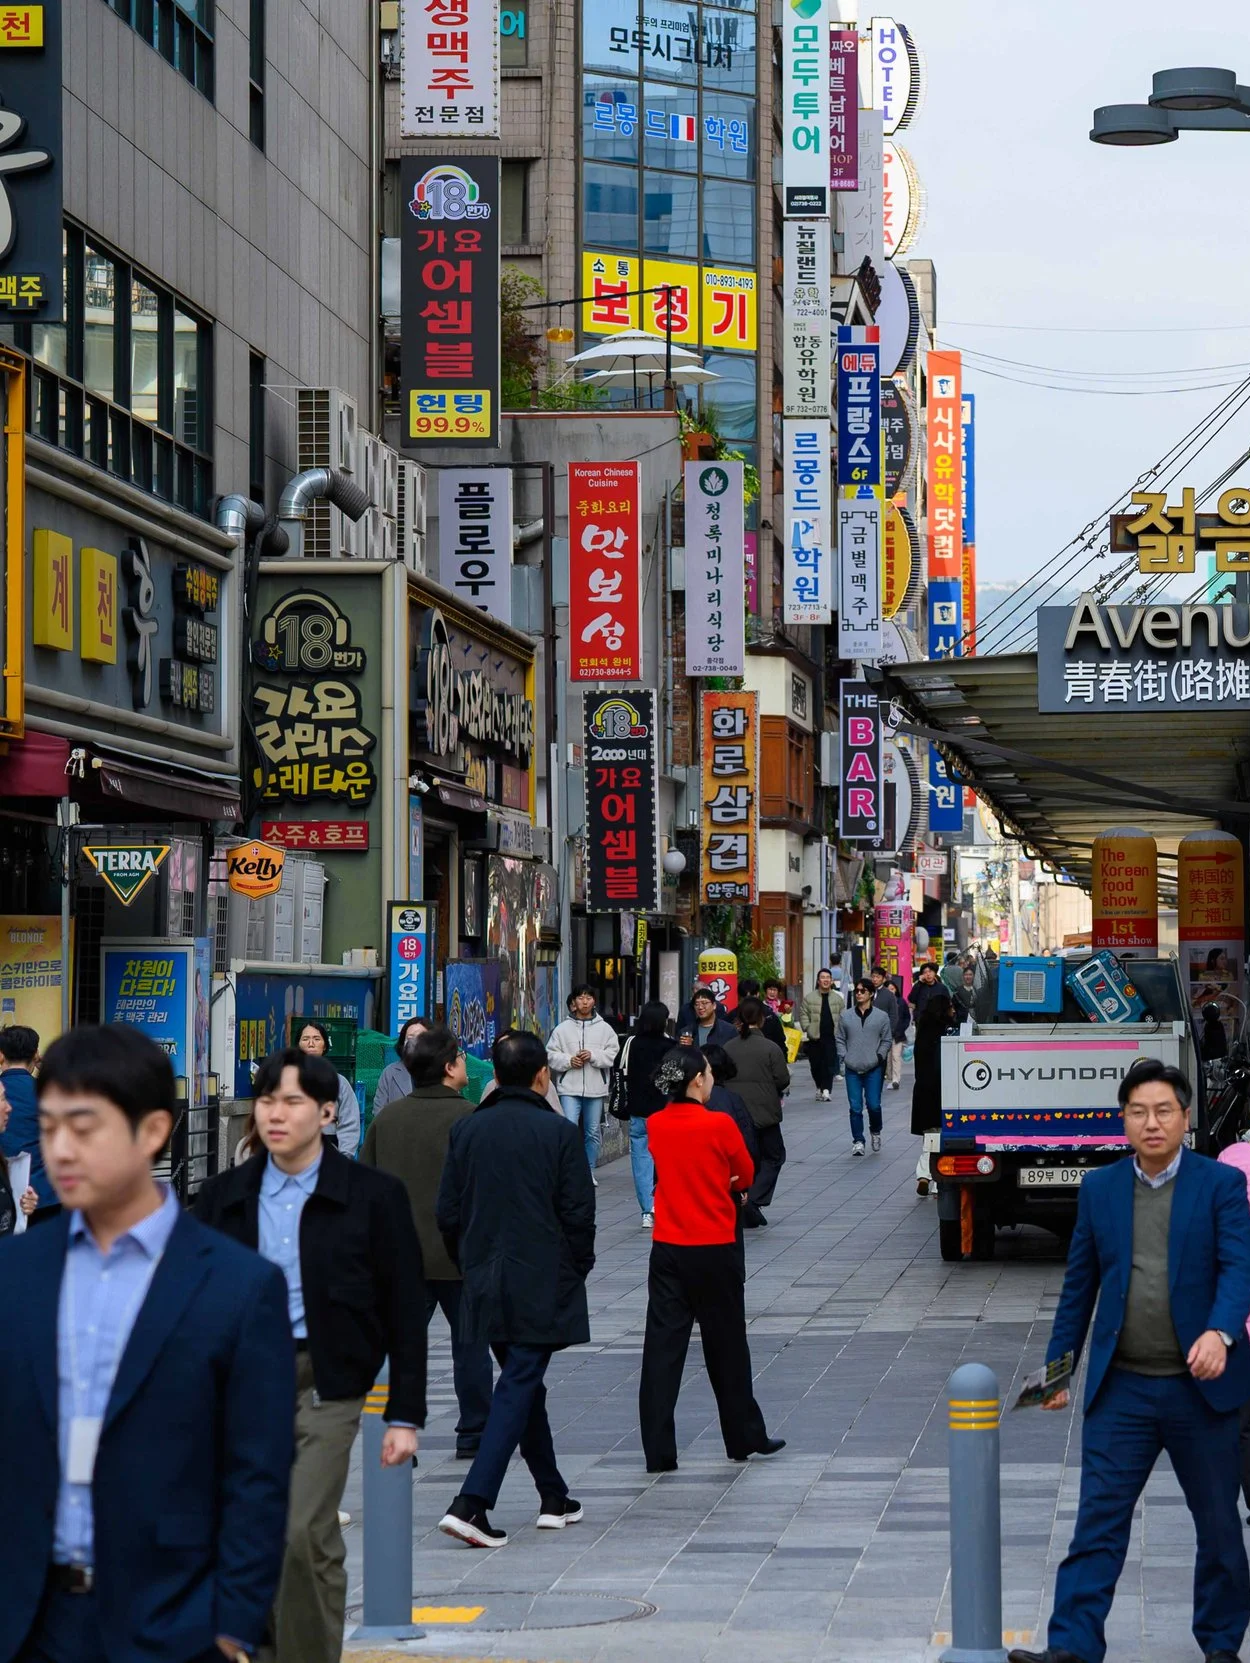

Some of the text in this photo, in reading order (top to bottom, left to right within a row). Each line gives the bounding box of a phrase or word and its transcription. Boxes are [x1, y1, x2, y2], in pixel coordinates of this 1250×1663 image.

[878, 28, 897, 121] HOTEL
[792, 25, 820, 154] 모두투어
[414, 105, 485, 124] 전문점
[704, 116, 748, 153] 학원
[833, 168, 844, 176] 3F
[417, 230, 482, 254] 가요
[796, 225, 816, 285] 뉴질랜드
[705, 273, 754, 290] 010-8931-4193
[592, 277, 747, 340] 보청기
[419, 260, 474, 378] 어셈블
[792, 335, 822, 350] 합동
[842, 353, 875, 373] 에듀
[416, 394, 483, 415] 헌팅
[416, 417, 485, 433] 99.9%
[847, 377, 872, 464] 프랑스
[574, 468, 633, 477] Korean Chinese
[793, 433, 821, 510] 르몽드
[851, 467, 868, 480] 6F
[588, 479, 618, 488] Cuisine
[933, 407, 956, 560] 시사유학닷컴
[576, 501, 631, 515] 중화요리
[454, 482, 496, 614] 플로우
[704, 501, 726, 653] 청록미나리식당
[792, 547, 823, 603] 학원
[850, 526, 869, 616] 금별맥주
[580, 524, 629, 651] 만보성
[580, 658, 632, 668] 연회석 완비
[692, 665, 738, 673] 02-738-0049
[844, 694, 878, 708] THE
[846, 716, 876, 818] BAR
[595, 768, 642, 788] 가요
[706, 707, 752, 873] 화로삼겹
[600, 794, 641, 900] 어셈블
[1100, 848, 1126, 862] The
[93, 851, 158, 874] TERRA
[229, 858, 282, 881] Kelly
[920, 857, 945, 869] 여관
[1100, 863, 1149, 877] Korean
[706, 883, 749, 899] 안동네
[1101, 878, 1134, 892] food
[1102, 893, 1138, 907] show
[1111, 920, 1137, 935] 1st
[10, 932, 44, 944] BLONDE
[402, 938, 417, 950] 18
[1097, 935, 1153, 945] in the show
[123, 960, 174, 977] 차원이
[119, 979, 177, 997] 다르다!
[115, 1000, 156, 1011] 테라만의
[126, 1012, 168, 1023] 맥주 관리
